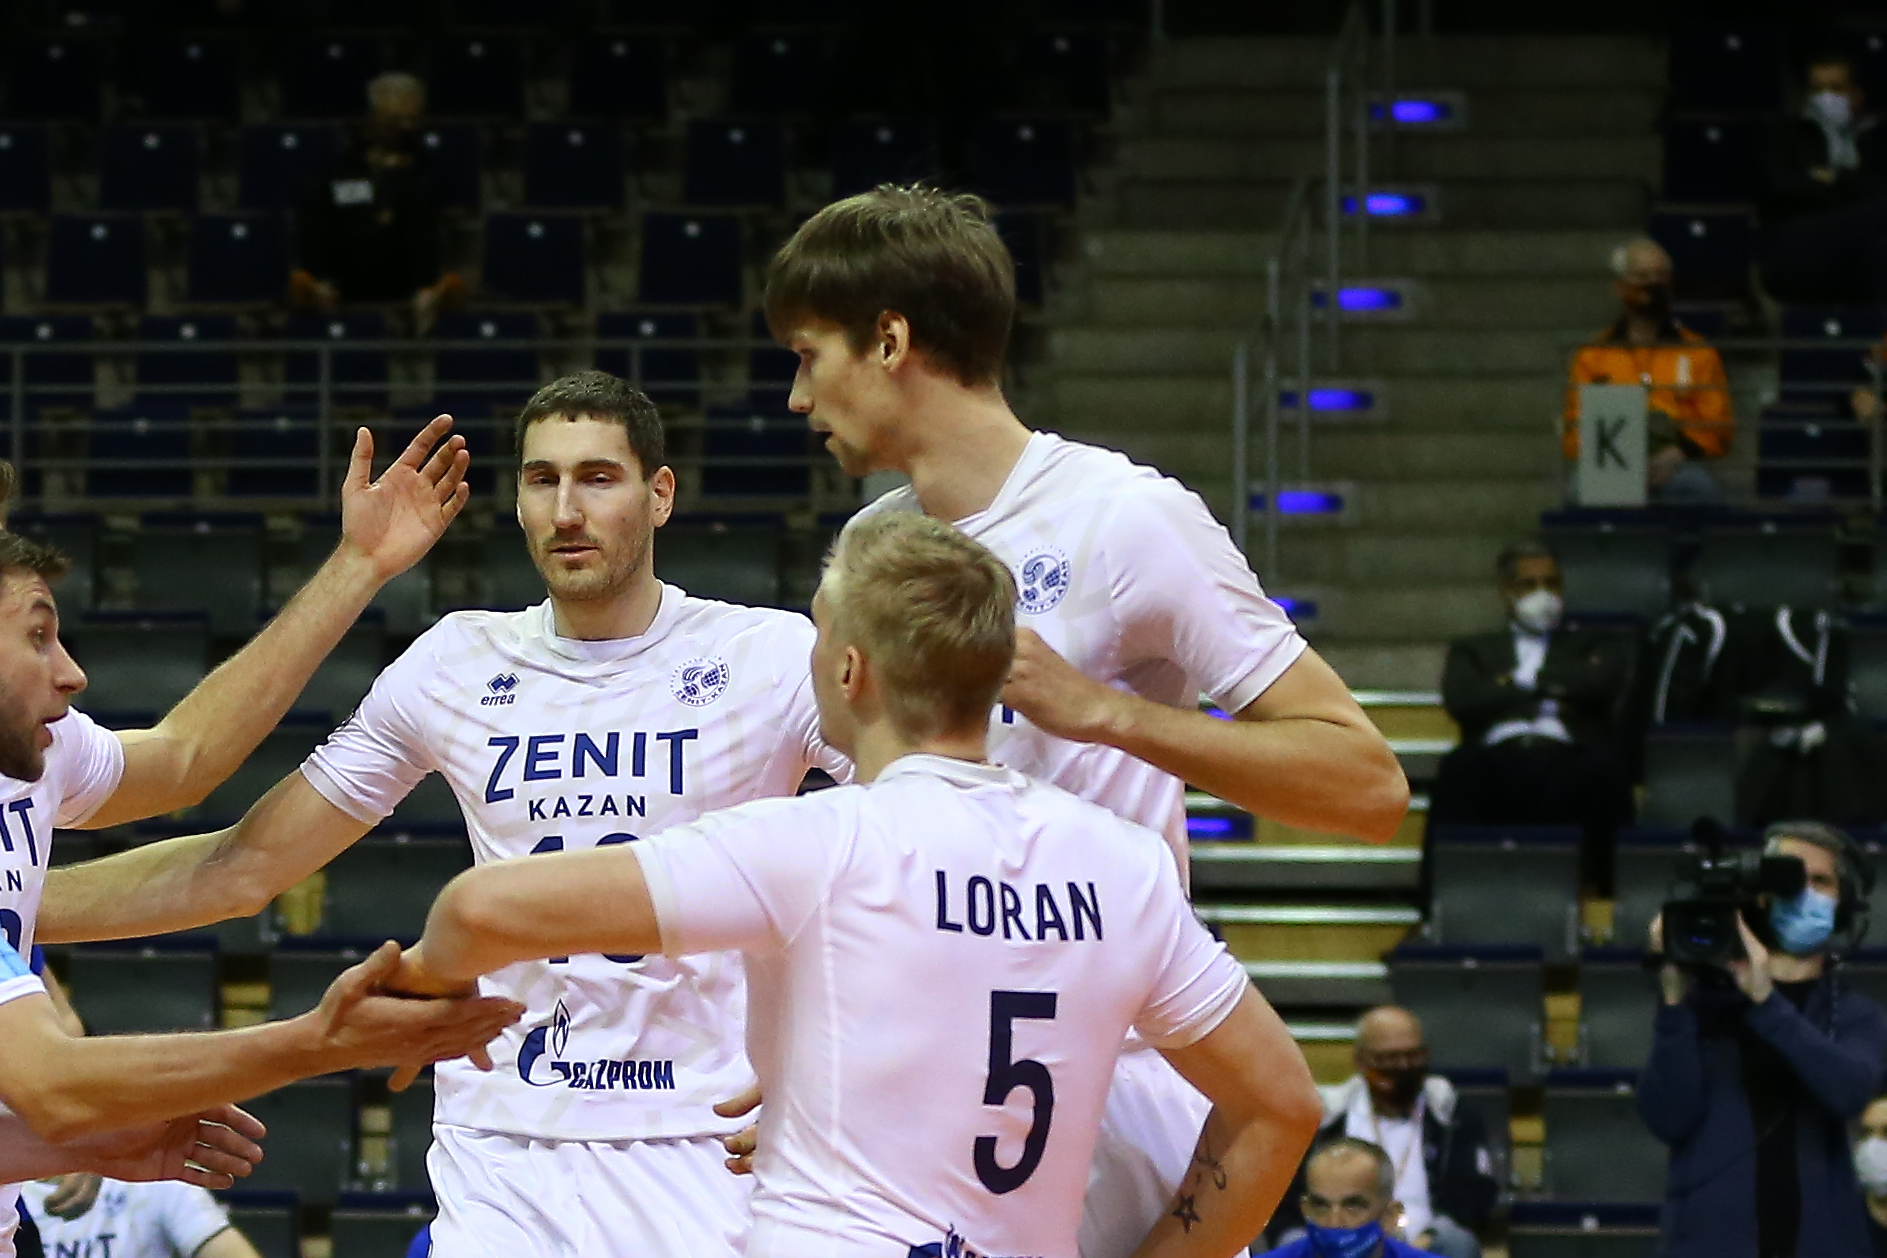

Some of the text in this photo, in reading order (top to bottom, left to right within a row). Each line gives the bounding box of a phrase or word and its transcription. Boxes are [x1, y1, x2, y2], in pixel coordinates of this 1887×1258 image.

[1593, 416, 1629, 471] K
[484, 728, 699, 804] ZENIT
[528, 794, 647, 821] KAZAN
[934, 869, 1103, 942] LORAN
[568, 1058, 676, 1090] GAZPROM
[971, 989, 1059, 1196] 5
